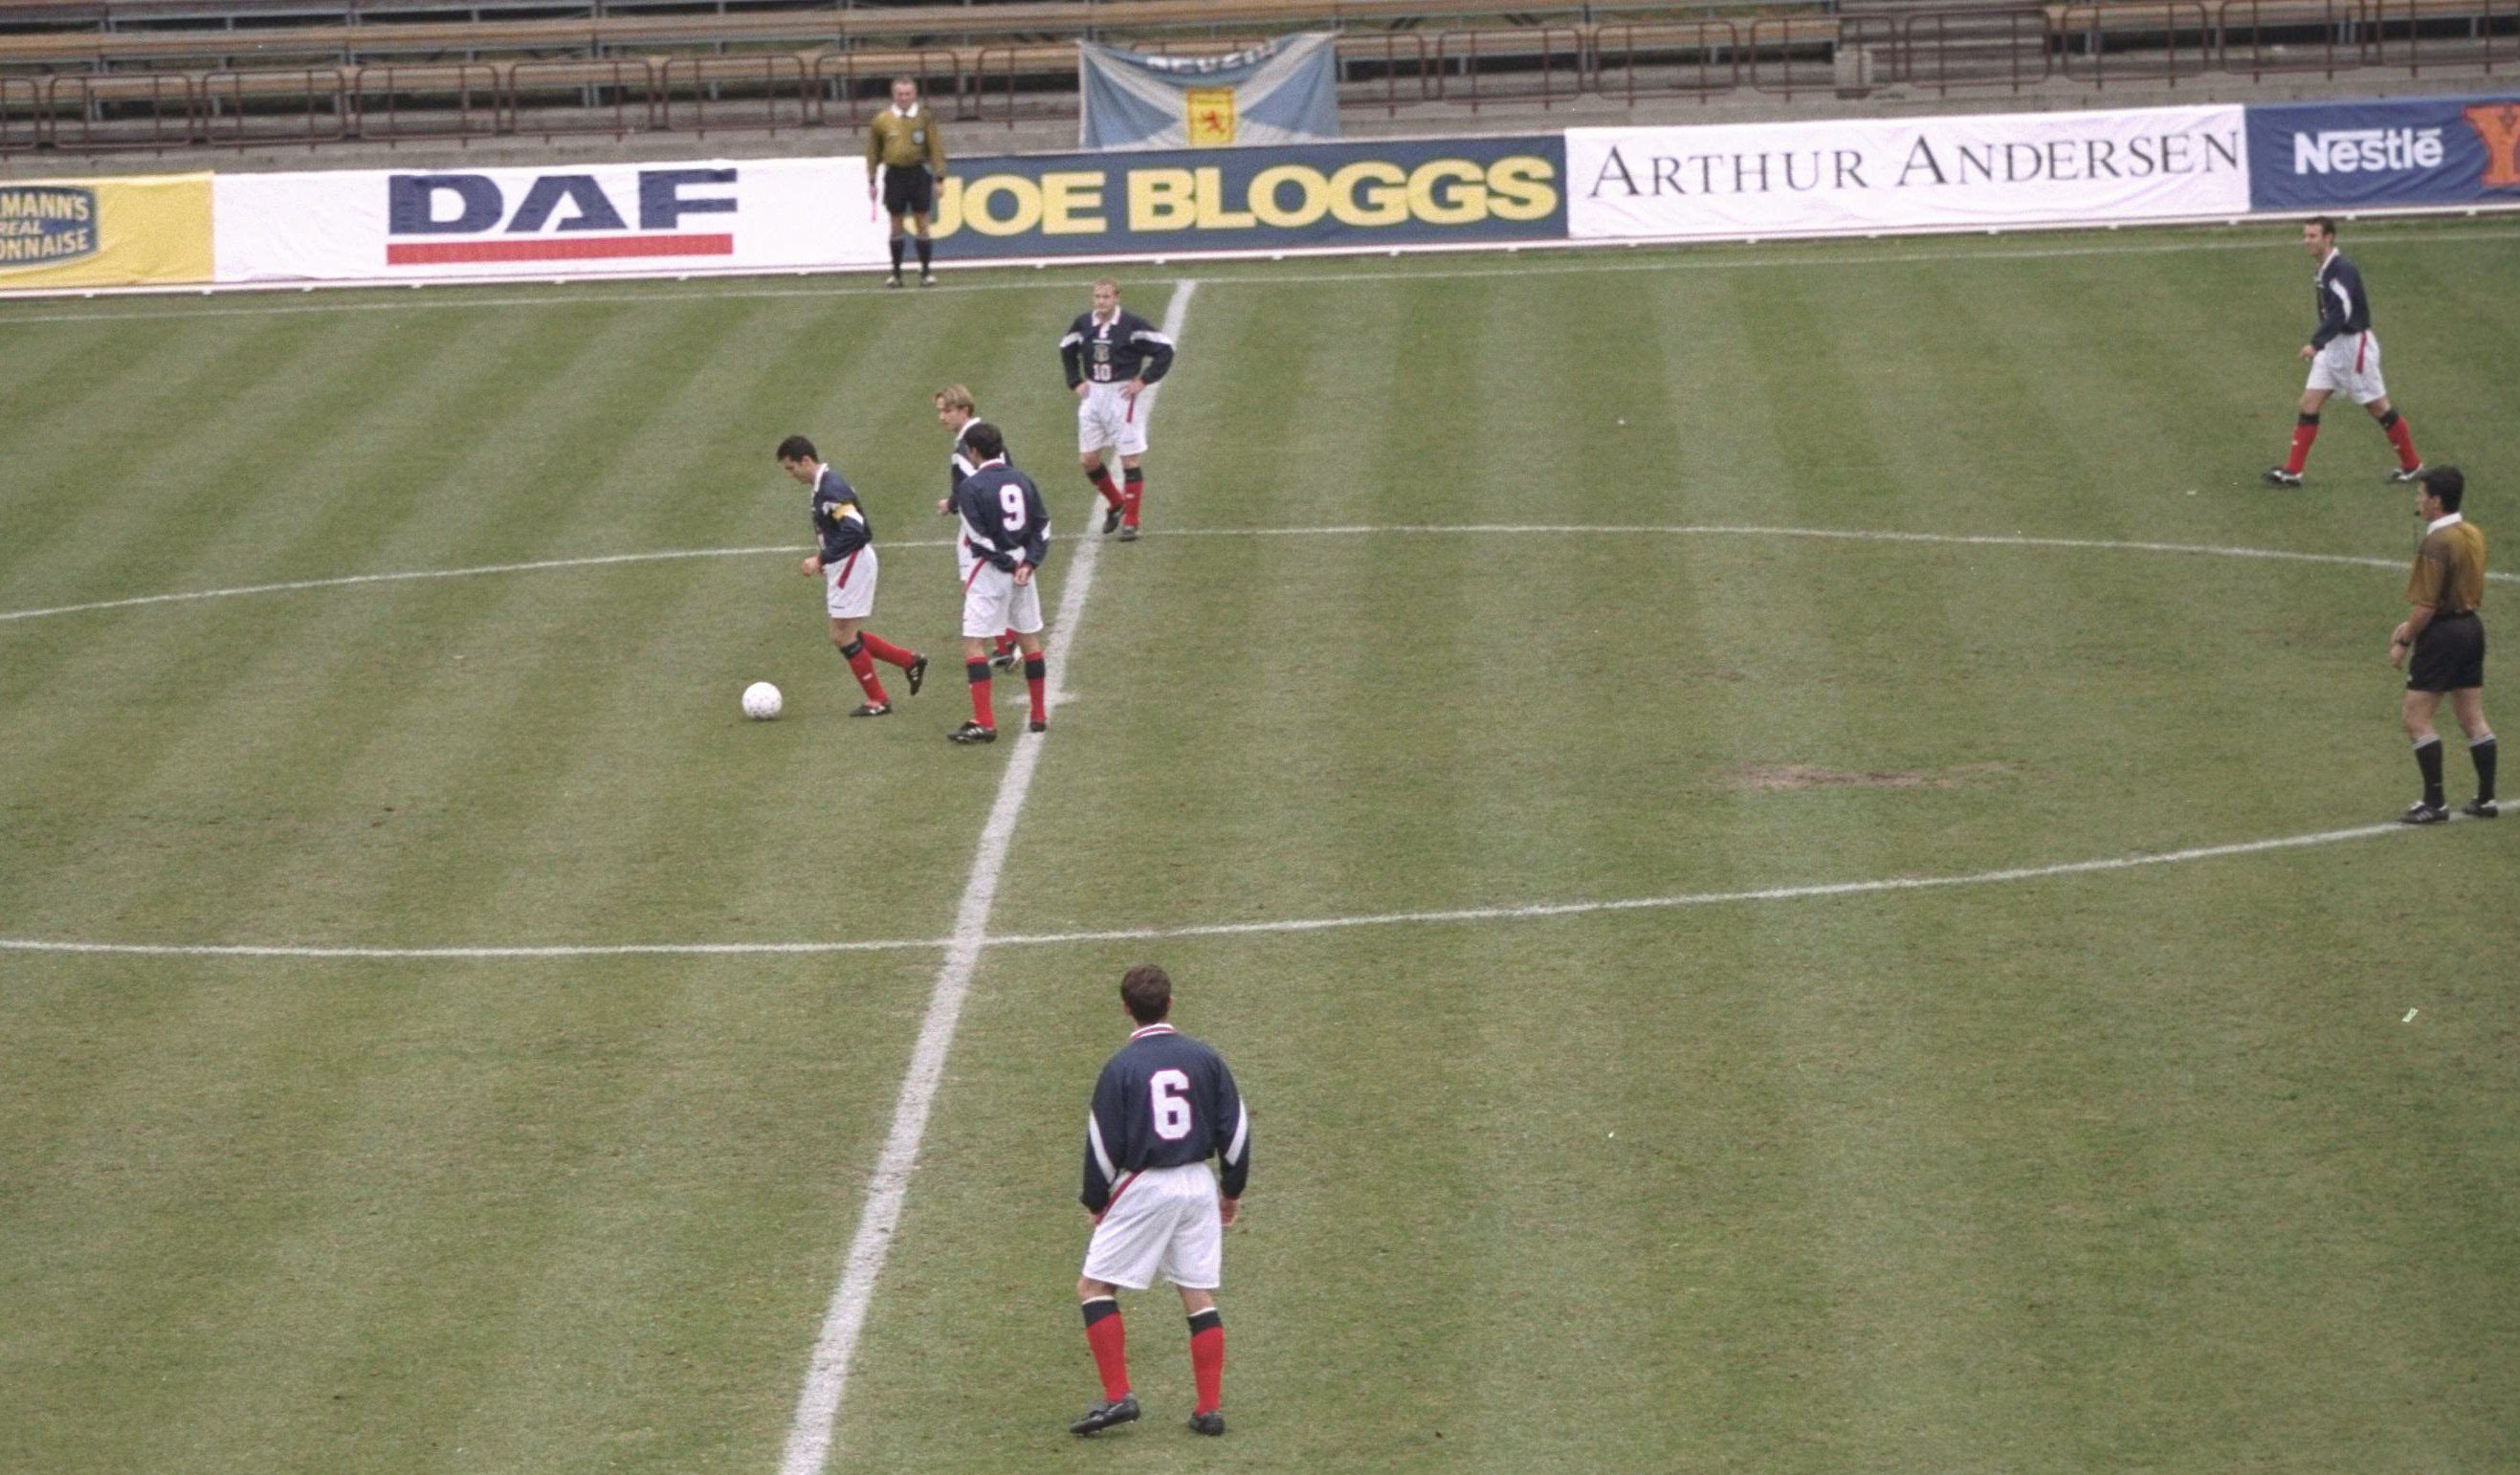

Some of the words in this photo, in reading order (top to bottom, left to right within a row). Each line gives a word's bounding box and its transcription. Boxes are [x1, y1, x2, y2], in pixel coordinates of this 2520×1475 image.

[902, 171, 1107, 240] JOE
[1128, 156, 1558, 231] BLOGGS
[1587, 144, 1869, 199] ARTHUR
[1894, 129, 2240, 187] ANDERSEN
[387, 167, 738, 235] DAF
[1093, 363, 1112, 381] 10
[999, 483, 1026, 532] 9
[1150, 1068, 1191, 1140] 6
